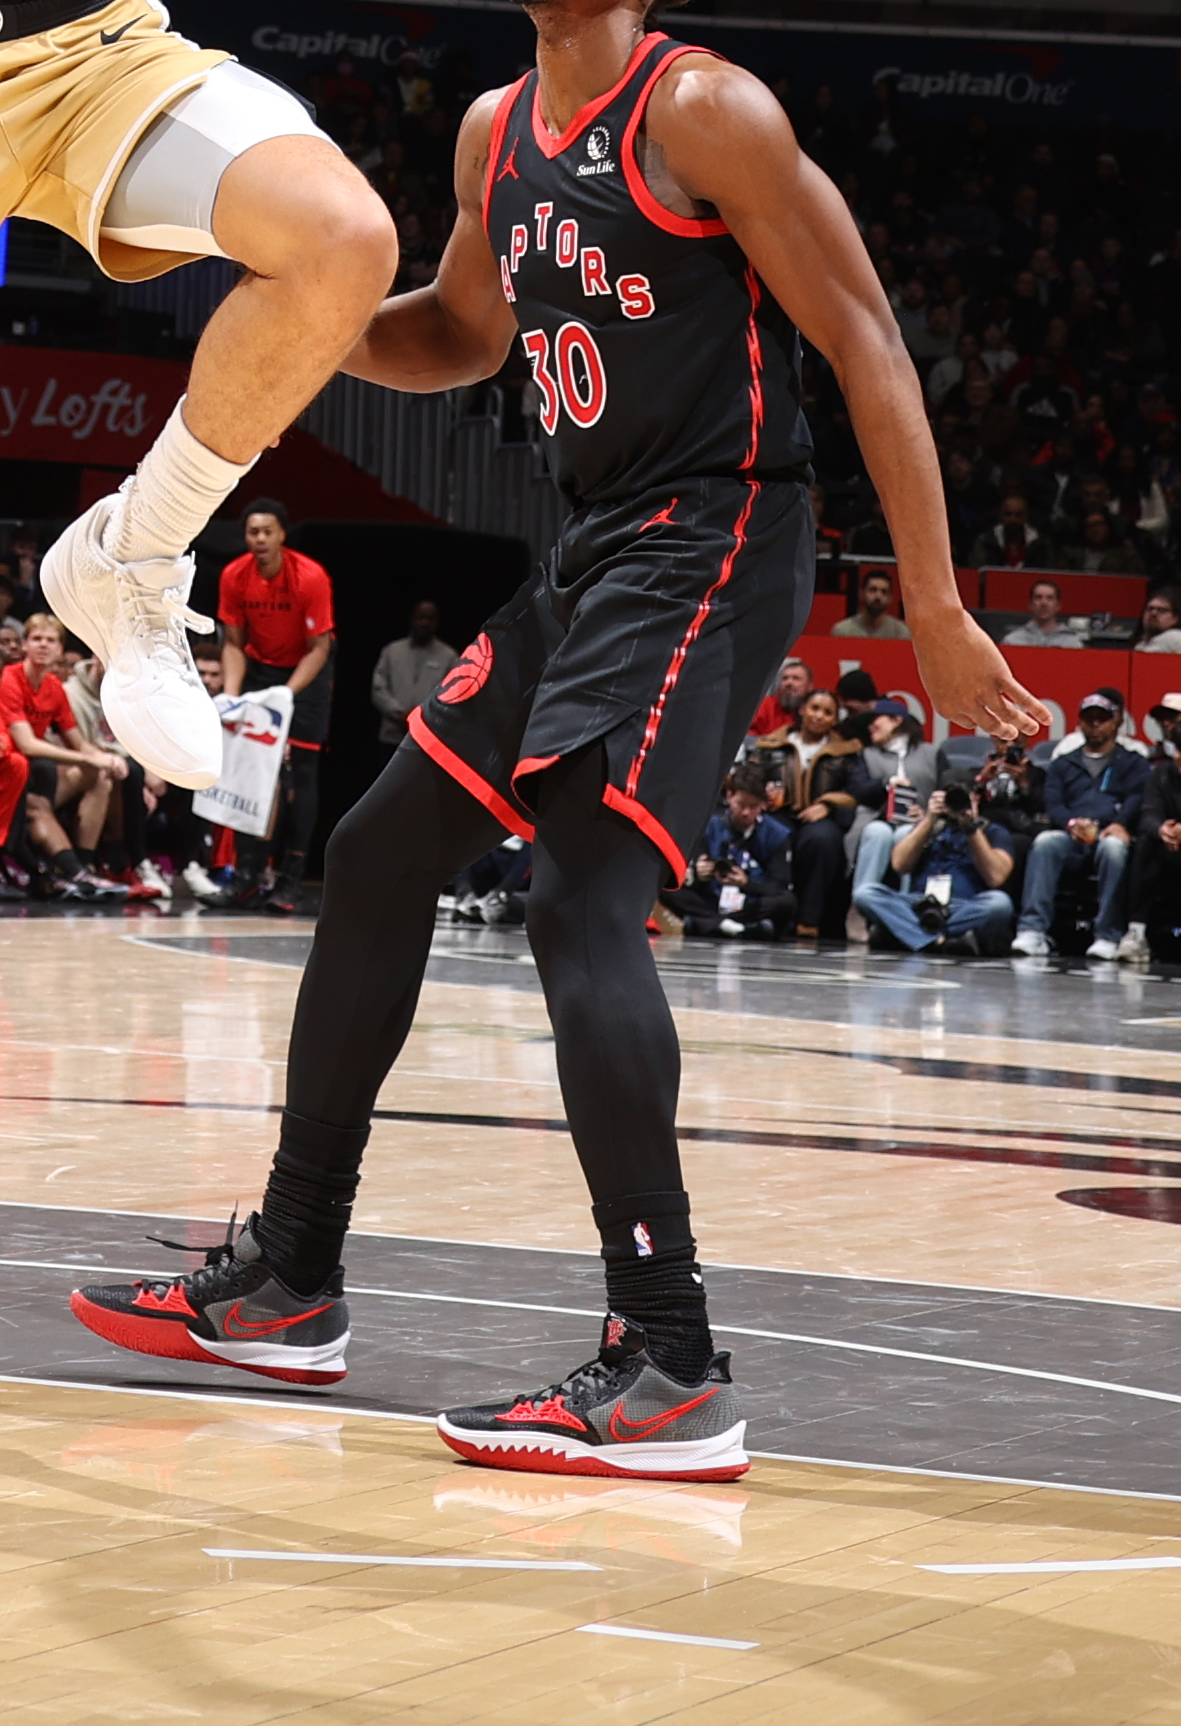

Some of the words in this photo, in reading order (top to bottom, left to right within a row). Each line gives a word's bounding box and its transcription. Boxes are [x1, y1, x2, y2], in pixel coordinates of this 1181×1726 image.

[575, 161, 596, 177] Sun
[596, 158, 616, 174] Life
[500, 200, 656, 320] APTORS
[30, 377, 155, 441] Lofts
[520, 320, 608, 437] 30
